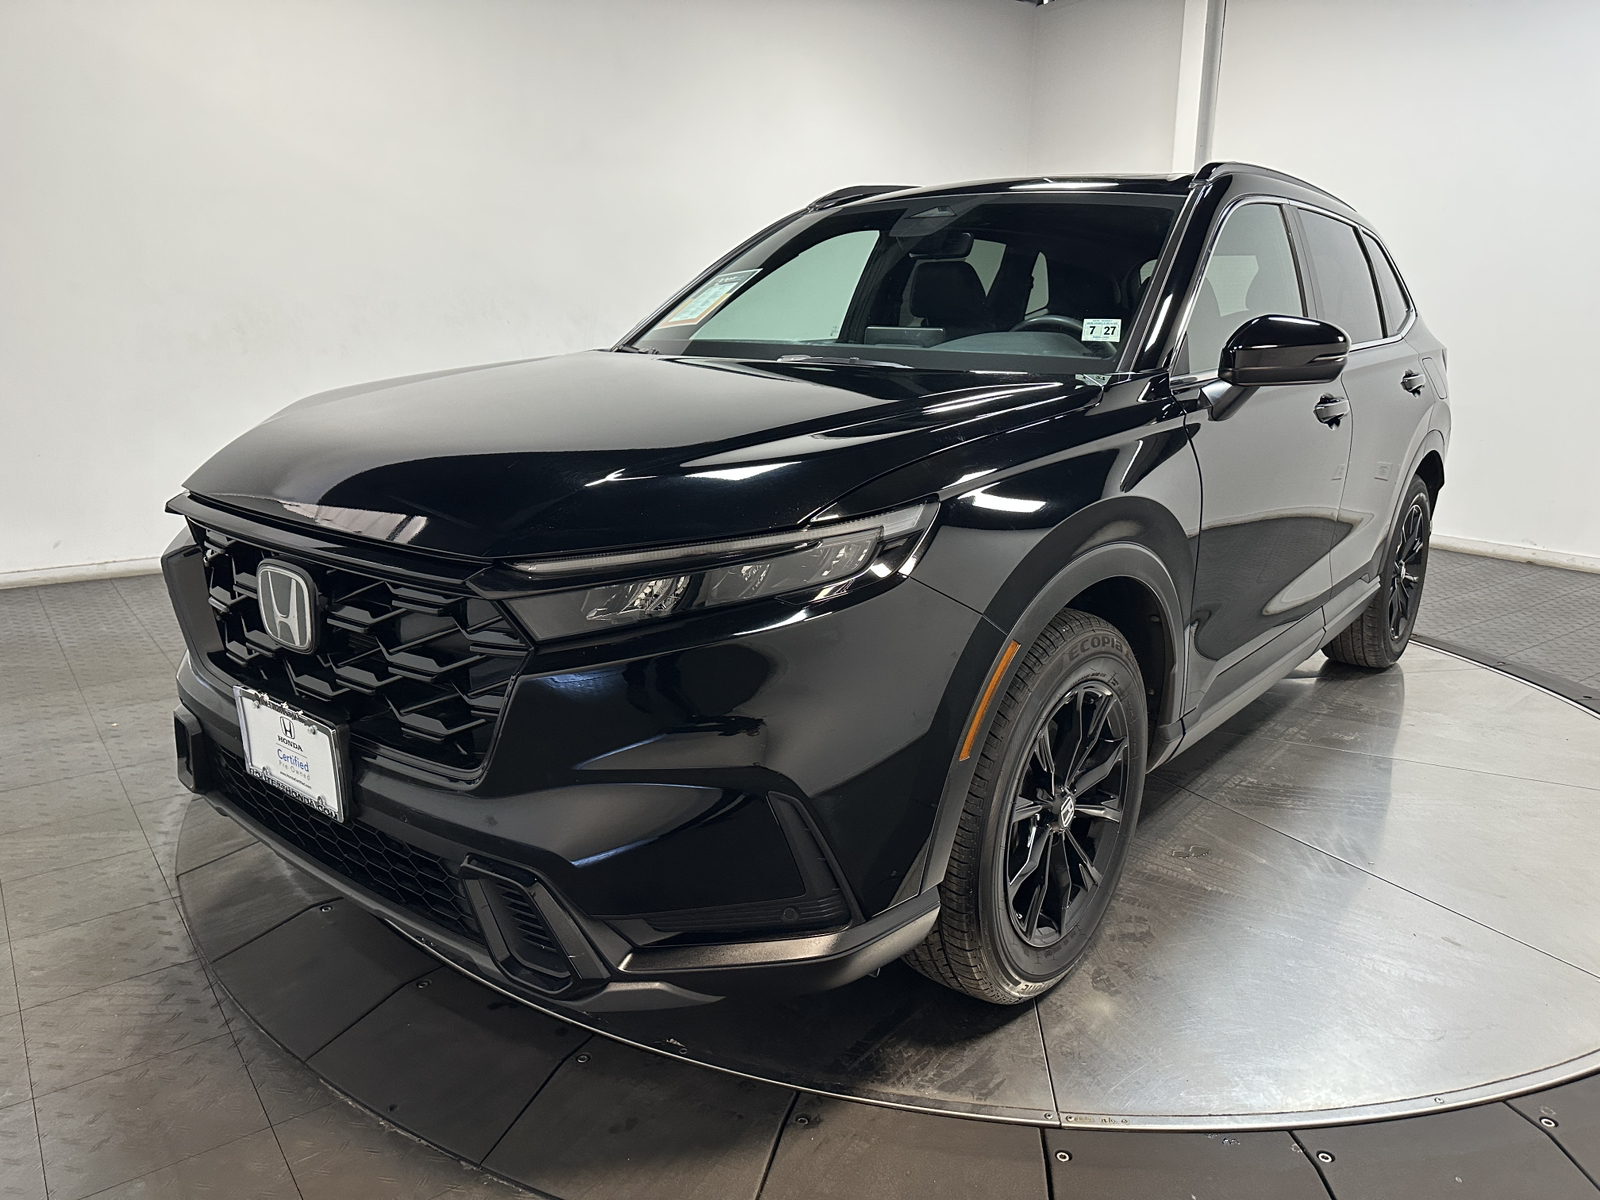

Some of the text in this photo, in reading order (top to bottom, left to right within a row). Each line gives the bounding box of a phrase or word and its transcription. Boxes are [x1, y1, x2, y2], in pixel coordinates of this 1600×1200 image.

[1089, 325, 1116, 335] 7 27
[277, 735, 304, 752] HONDA
[277, 748, 310, 773] Certified
